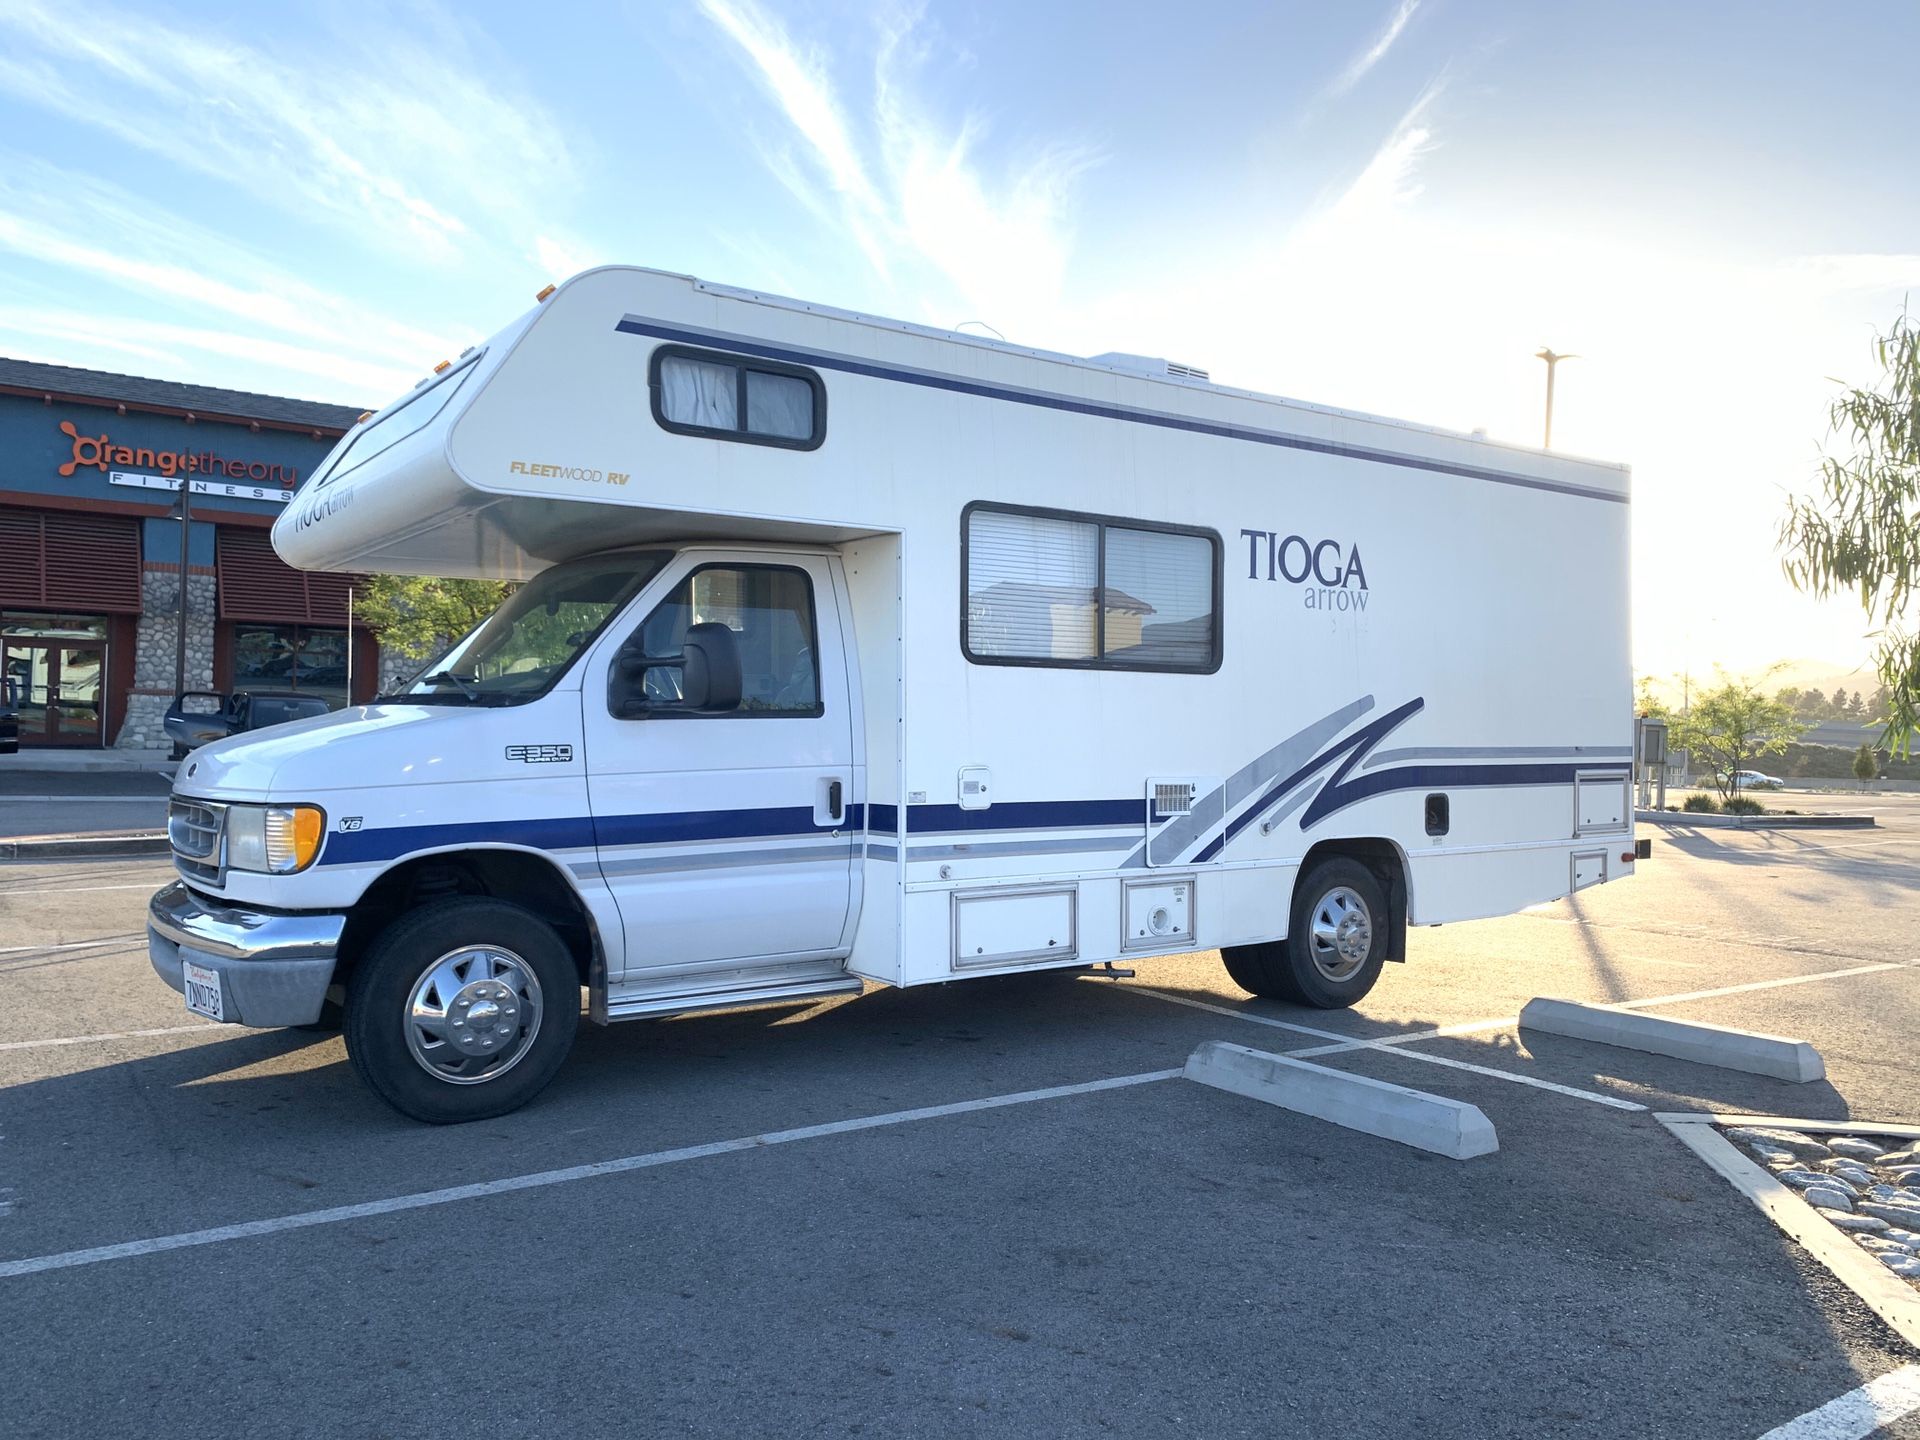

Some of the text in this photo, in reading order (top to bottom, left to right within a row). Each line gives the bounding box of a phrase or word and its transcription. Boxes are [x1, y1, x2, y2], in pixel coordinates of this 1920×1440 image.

[510, 461, 630, 485] FLEETWOOD RV
[112, 474, 292, 500] FITNESS
[1240, 528, 1369, 590] TIOGA
[1304, 587, 1369, 612] arrow
[340, 820, 360, 831] V8
